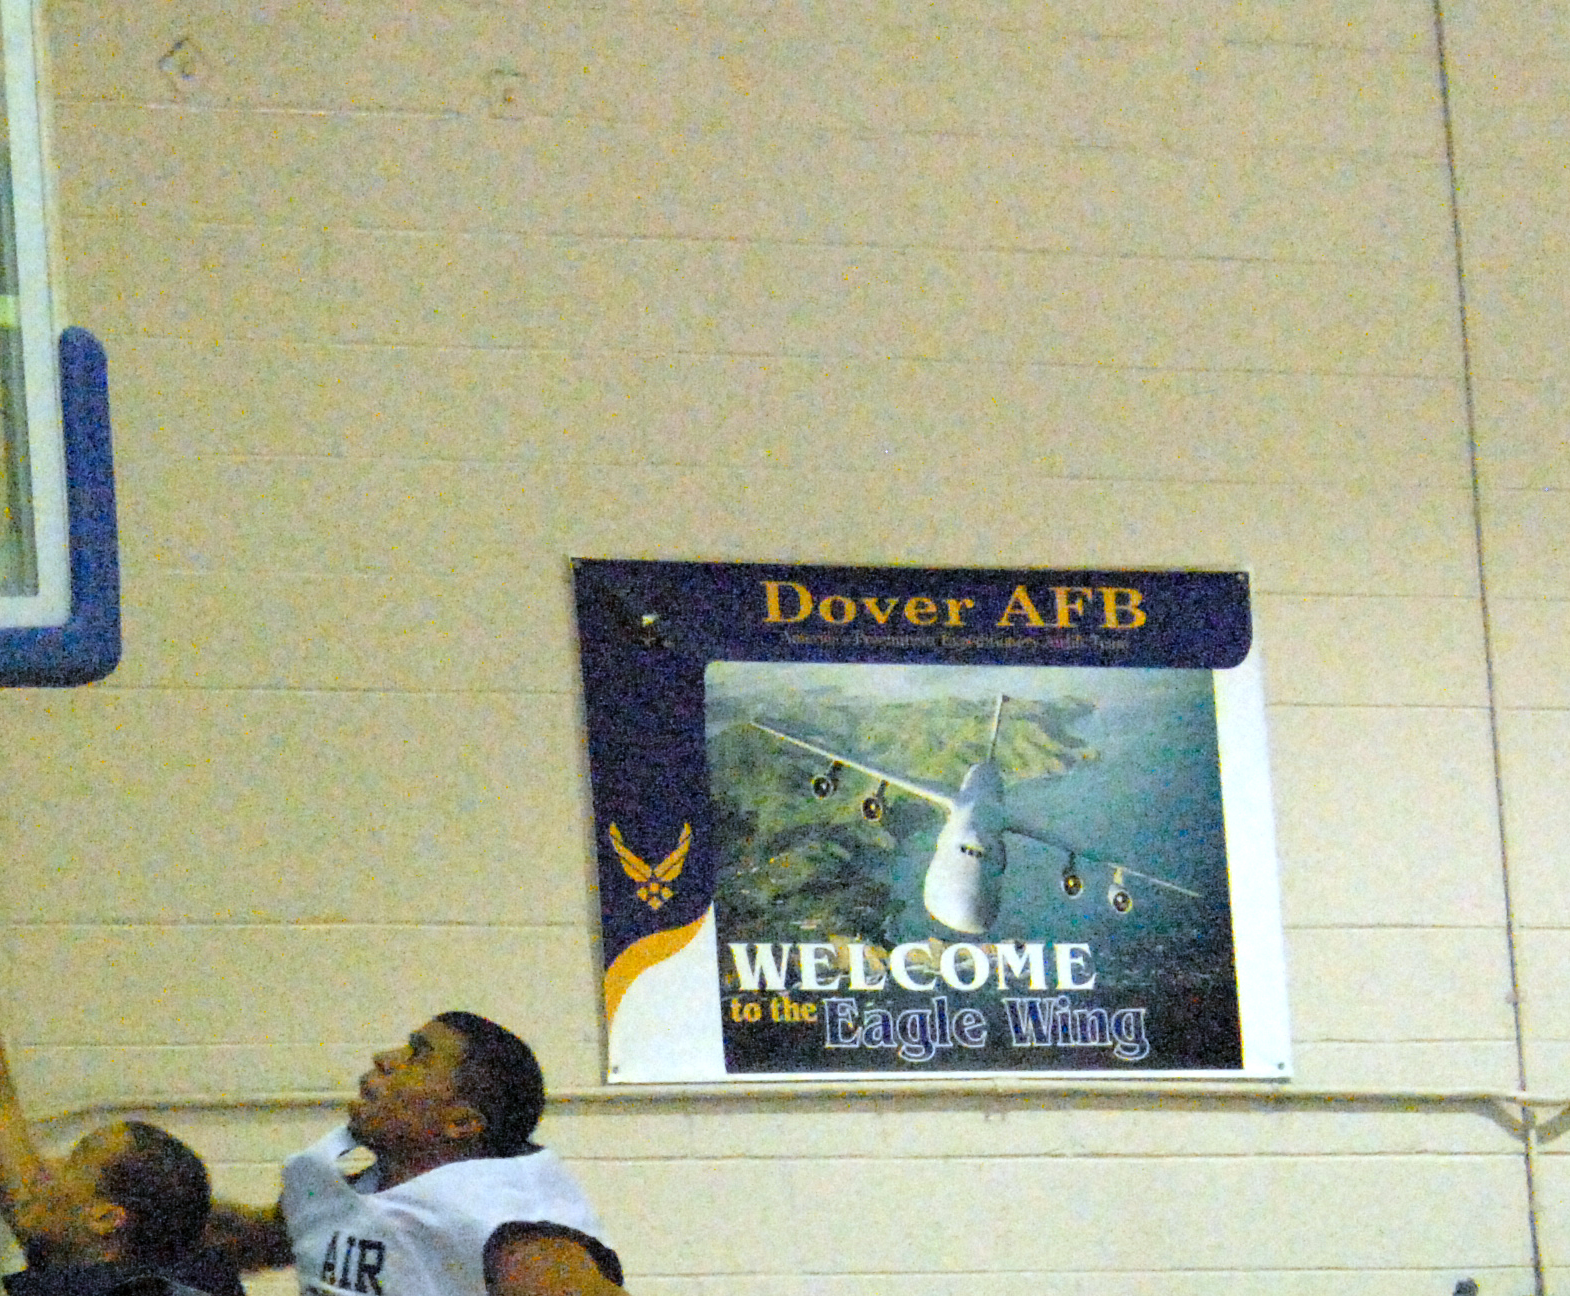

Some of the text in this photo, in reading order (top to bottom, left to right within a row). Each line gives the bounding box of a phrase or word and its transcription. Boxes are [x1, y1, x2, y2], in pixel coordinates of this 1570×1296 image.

[760, 580, 1148, 629] Dover AFB
[728, 942, 1098, 991] WELCOME
[730, 995, 1151, 1063] to the Eagle Wing
